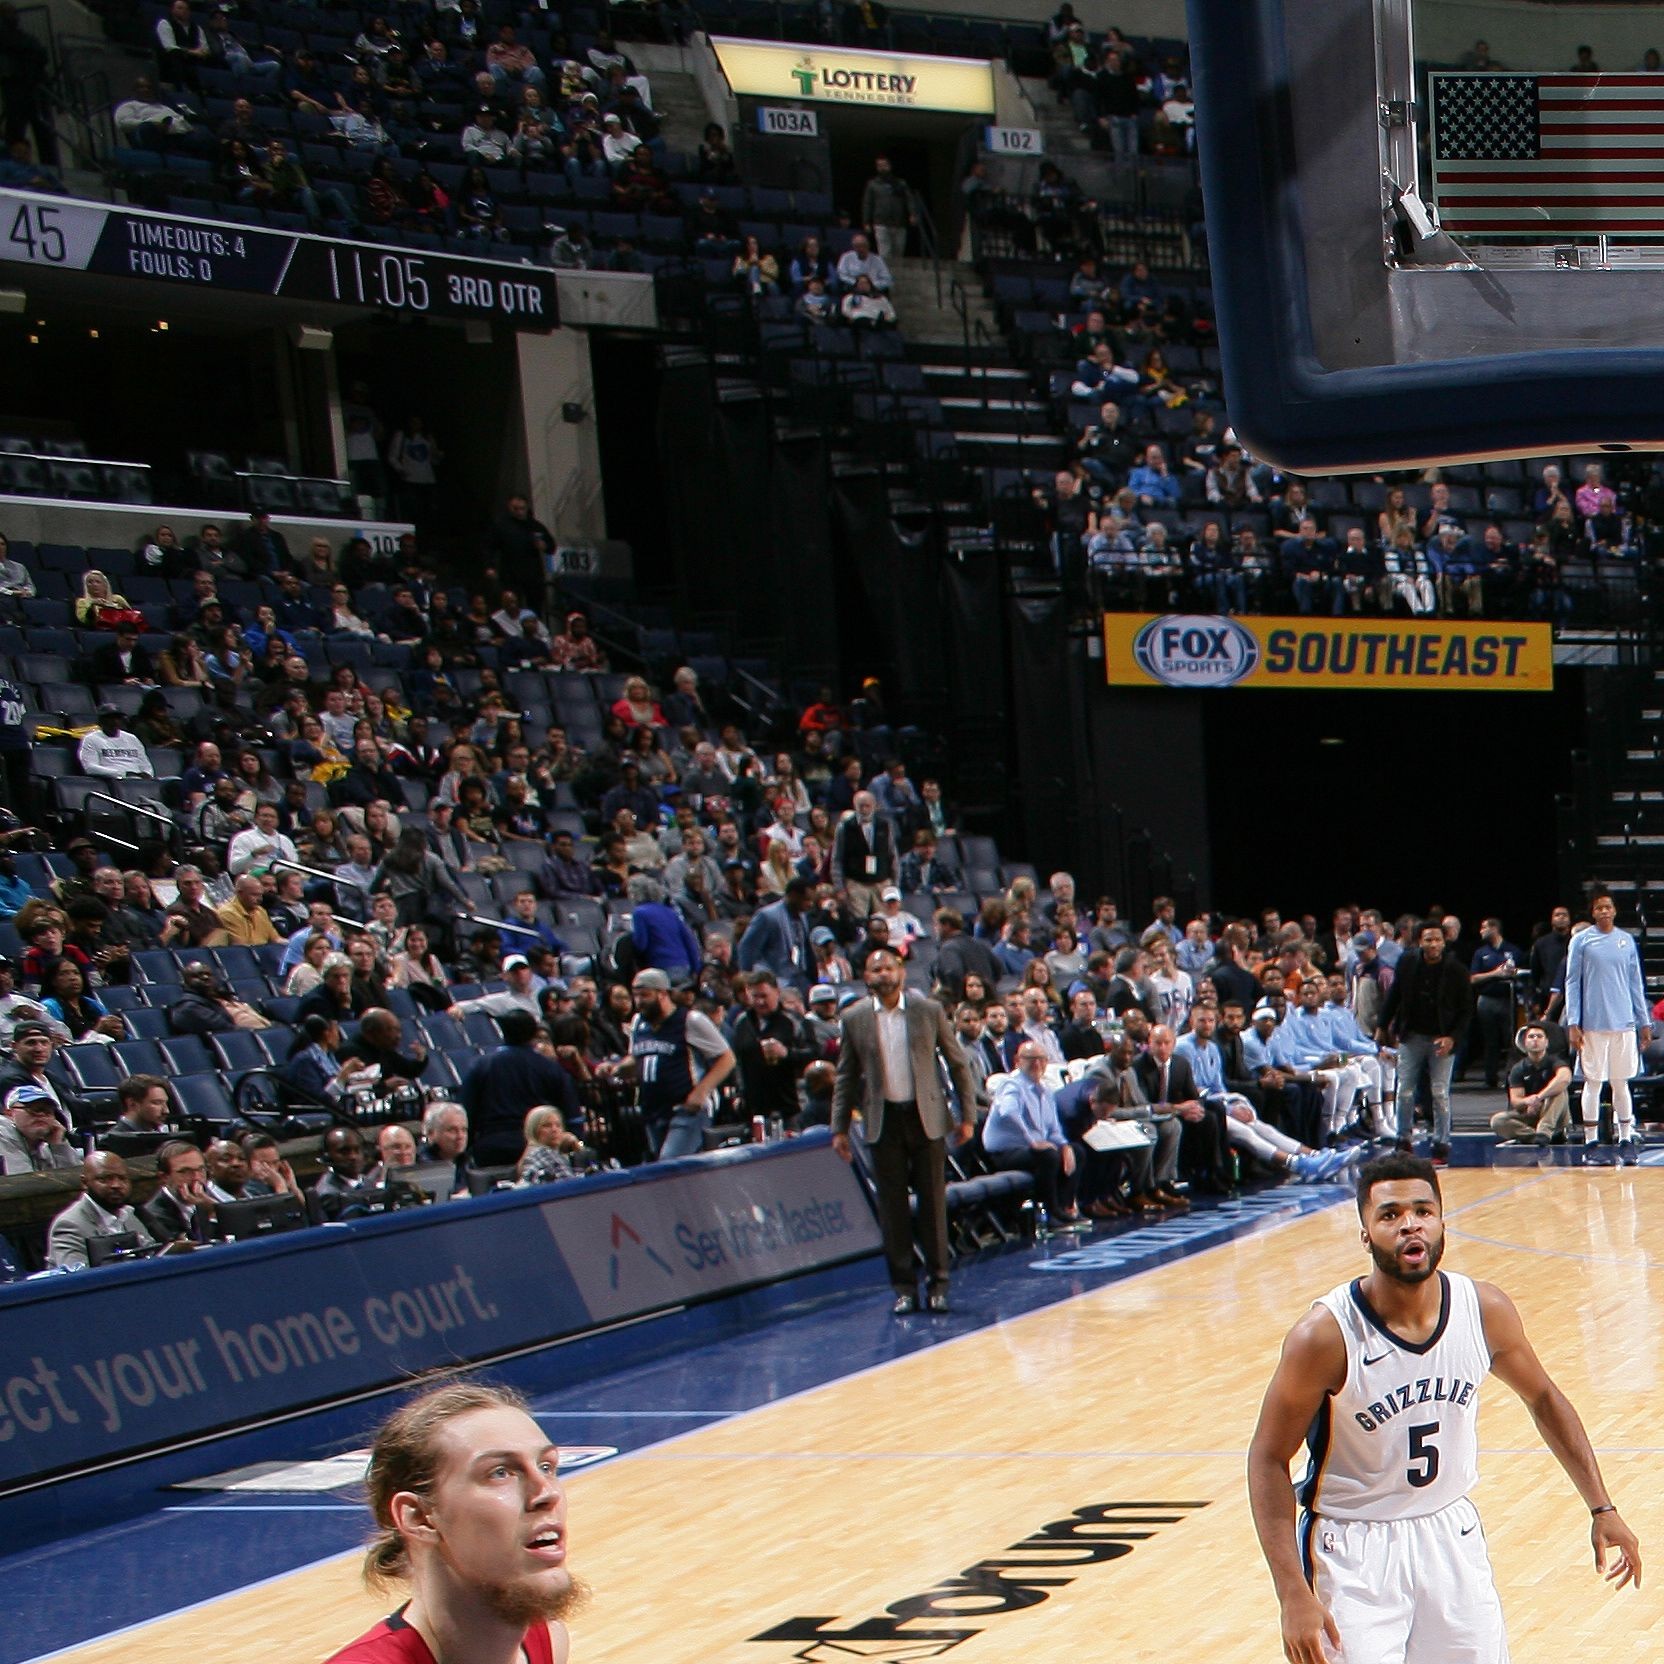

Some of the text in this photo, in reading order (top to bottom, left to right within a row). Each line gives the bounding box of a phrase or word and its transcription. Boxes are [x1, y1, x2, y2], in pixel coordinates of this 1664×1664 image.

[823, 68, 918, 93] LOTTERY
[824, 89, 916, 104] TENNESSEE
[767, 111, 813, 132] 103A
[1001, 130, 1031, 150] 102
[10, 204, 67, 262] 45
[126, 220, 246, 258] TIMEOUTS: 4
[129, 249, 213, 281] FOULS: 0
[330, 248, 430, 310] 11:05
[448, 274, 544, 315] 3RD QTR
[1161, 659, 1234, 675] SPORTS
[1162, 627, 1527, 677] FOX SOUTHEAST
[74, 1337, 208, 1434] your
[204, 1304, 361, 1383] home
[364, 1264, 498, 1346] court.
[1355, 1377, 1475, 1432] GRIZZLIE
[1407, 1420, 1440, 1488] 5
